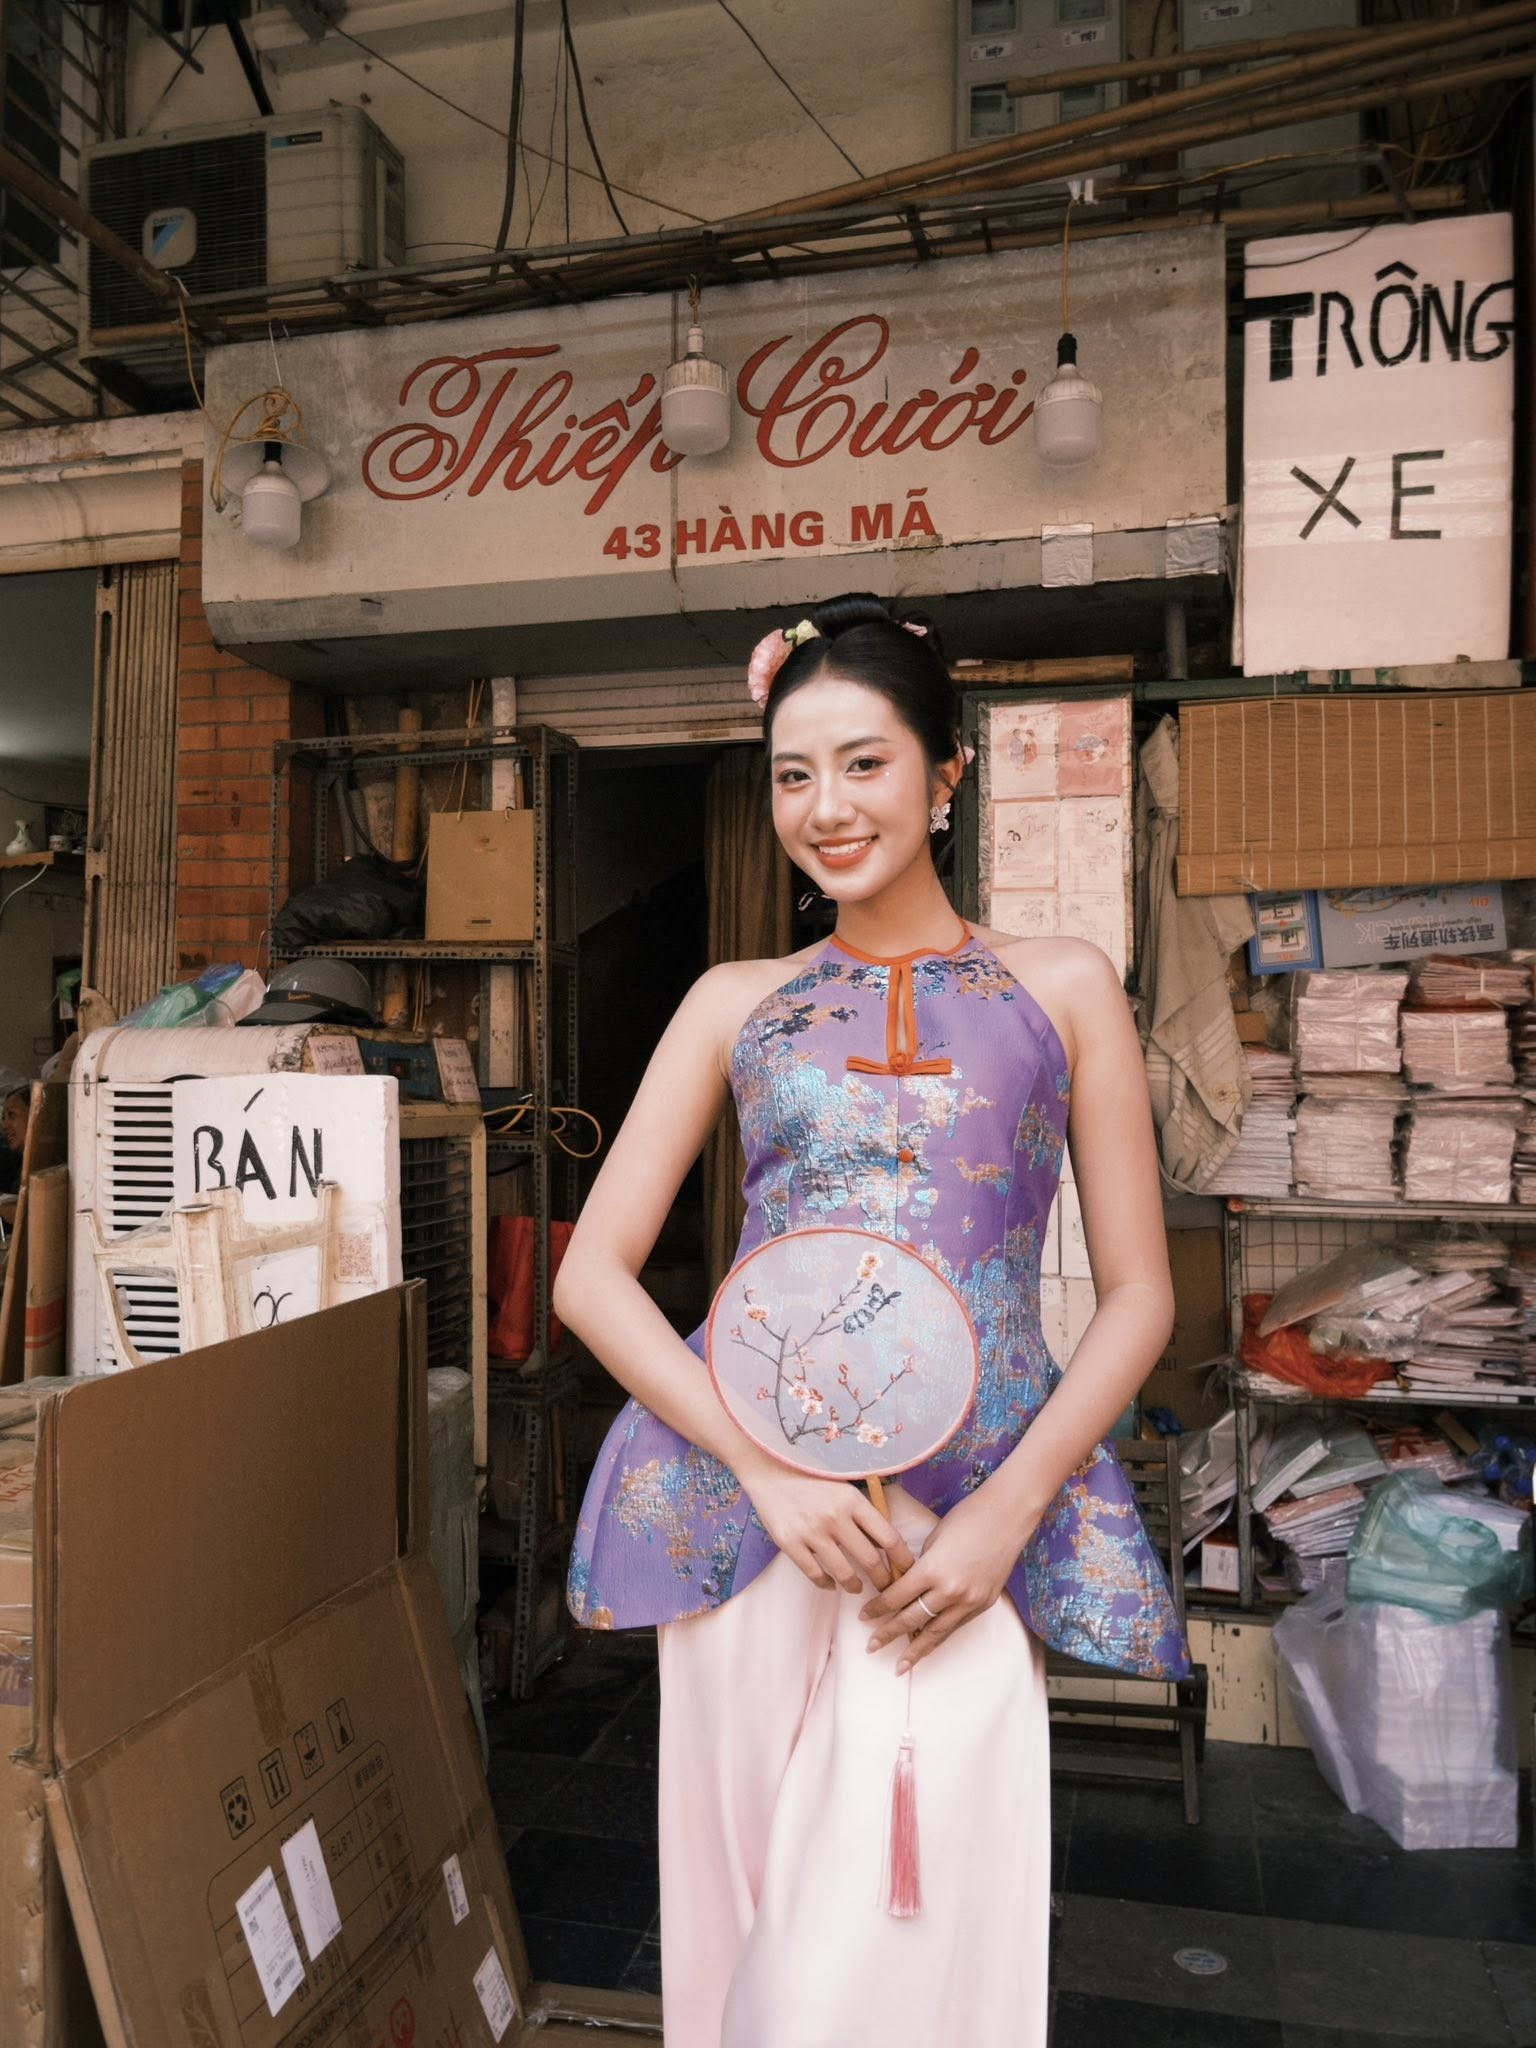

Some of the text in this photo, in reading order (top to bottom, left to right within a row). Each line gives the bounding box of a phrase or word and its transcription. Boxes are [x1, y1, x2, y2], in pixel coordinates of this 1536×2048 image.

[1244, 261, 1515, 383] TRÔNG
[603, 488, 938, 560] 43 HÀNG MÃ
[1290, 450, 1445, 540] XE
[1383, 923, 1496, 951] 高铁轨道列车
[193, 1087, 324, 1200] BÁN
